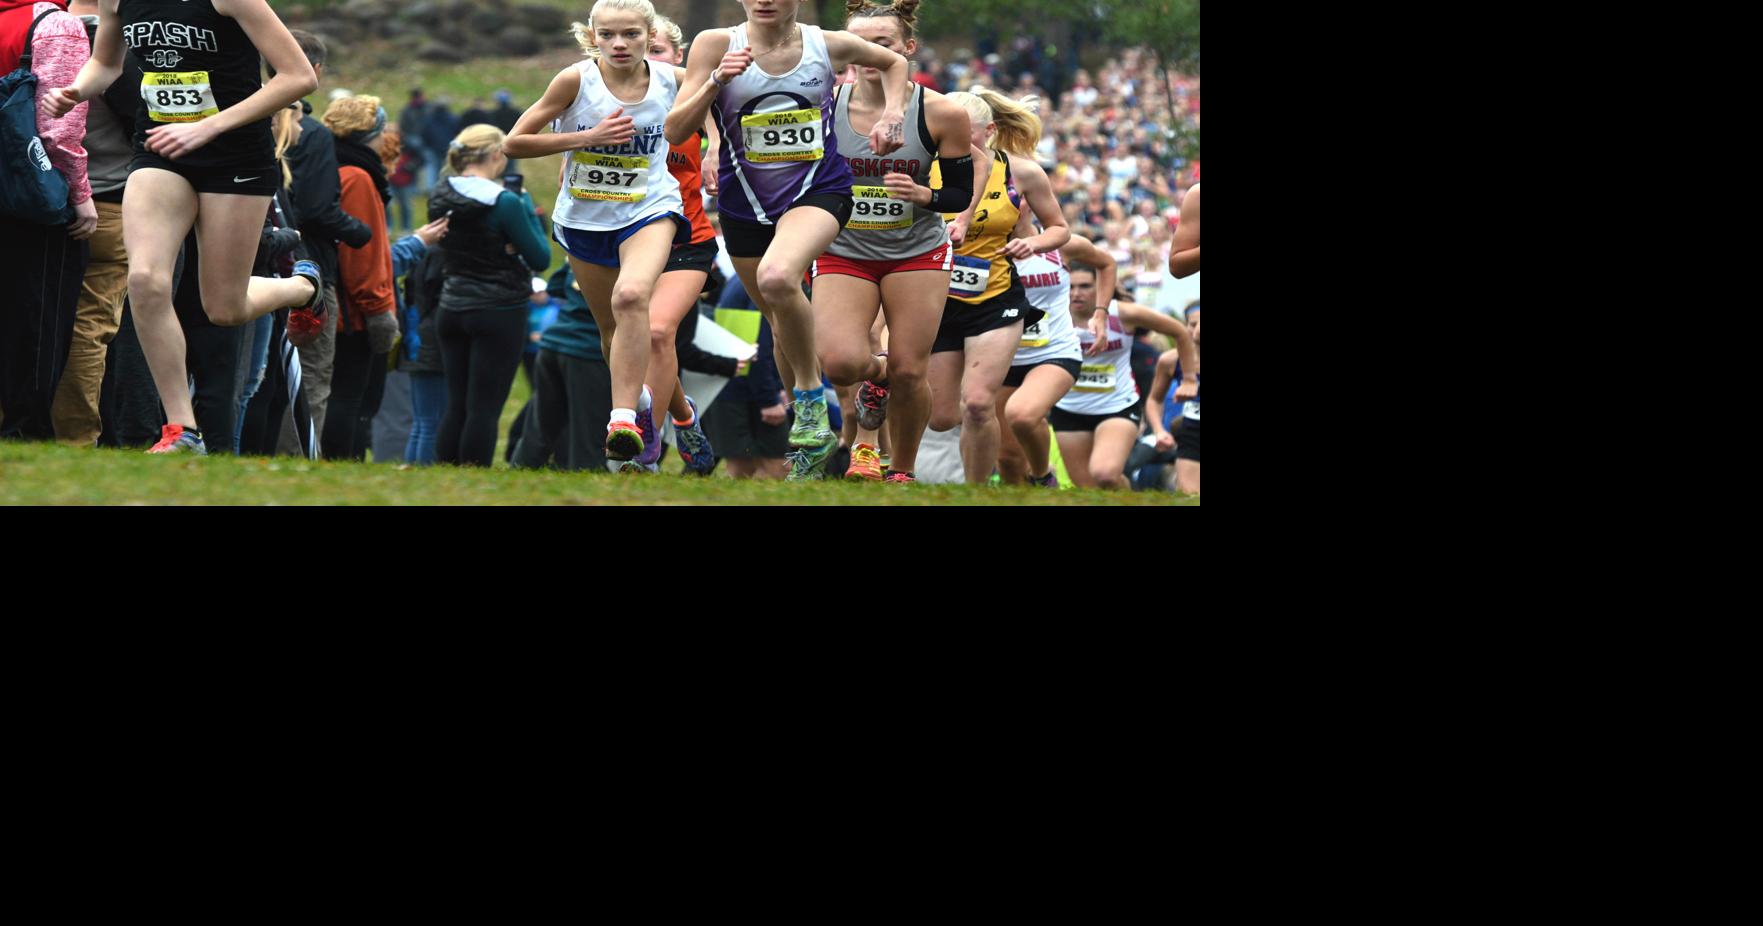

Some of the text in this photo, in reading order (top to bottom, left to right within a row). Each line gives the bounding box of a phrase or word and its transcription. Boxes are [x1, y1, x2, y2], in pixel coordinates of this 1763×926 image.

[123, 21, 218, 52] SPASH
[156, 89, 203, 106] 853
[768, 117, 798, 126] WIAA
[763, 127, 815, 147] 930
[595, 159, 624, 168] WIAA
[848, 157, 920, 178] SKEGO
[588, 169, 638, 187] 937
[856, 201, 904, 216] 958
[1002, 308, 1019, 318] NB
